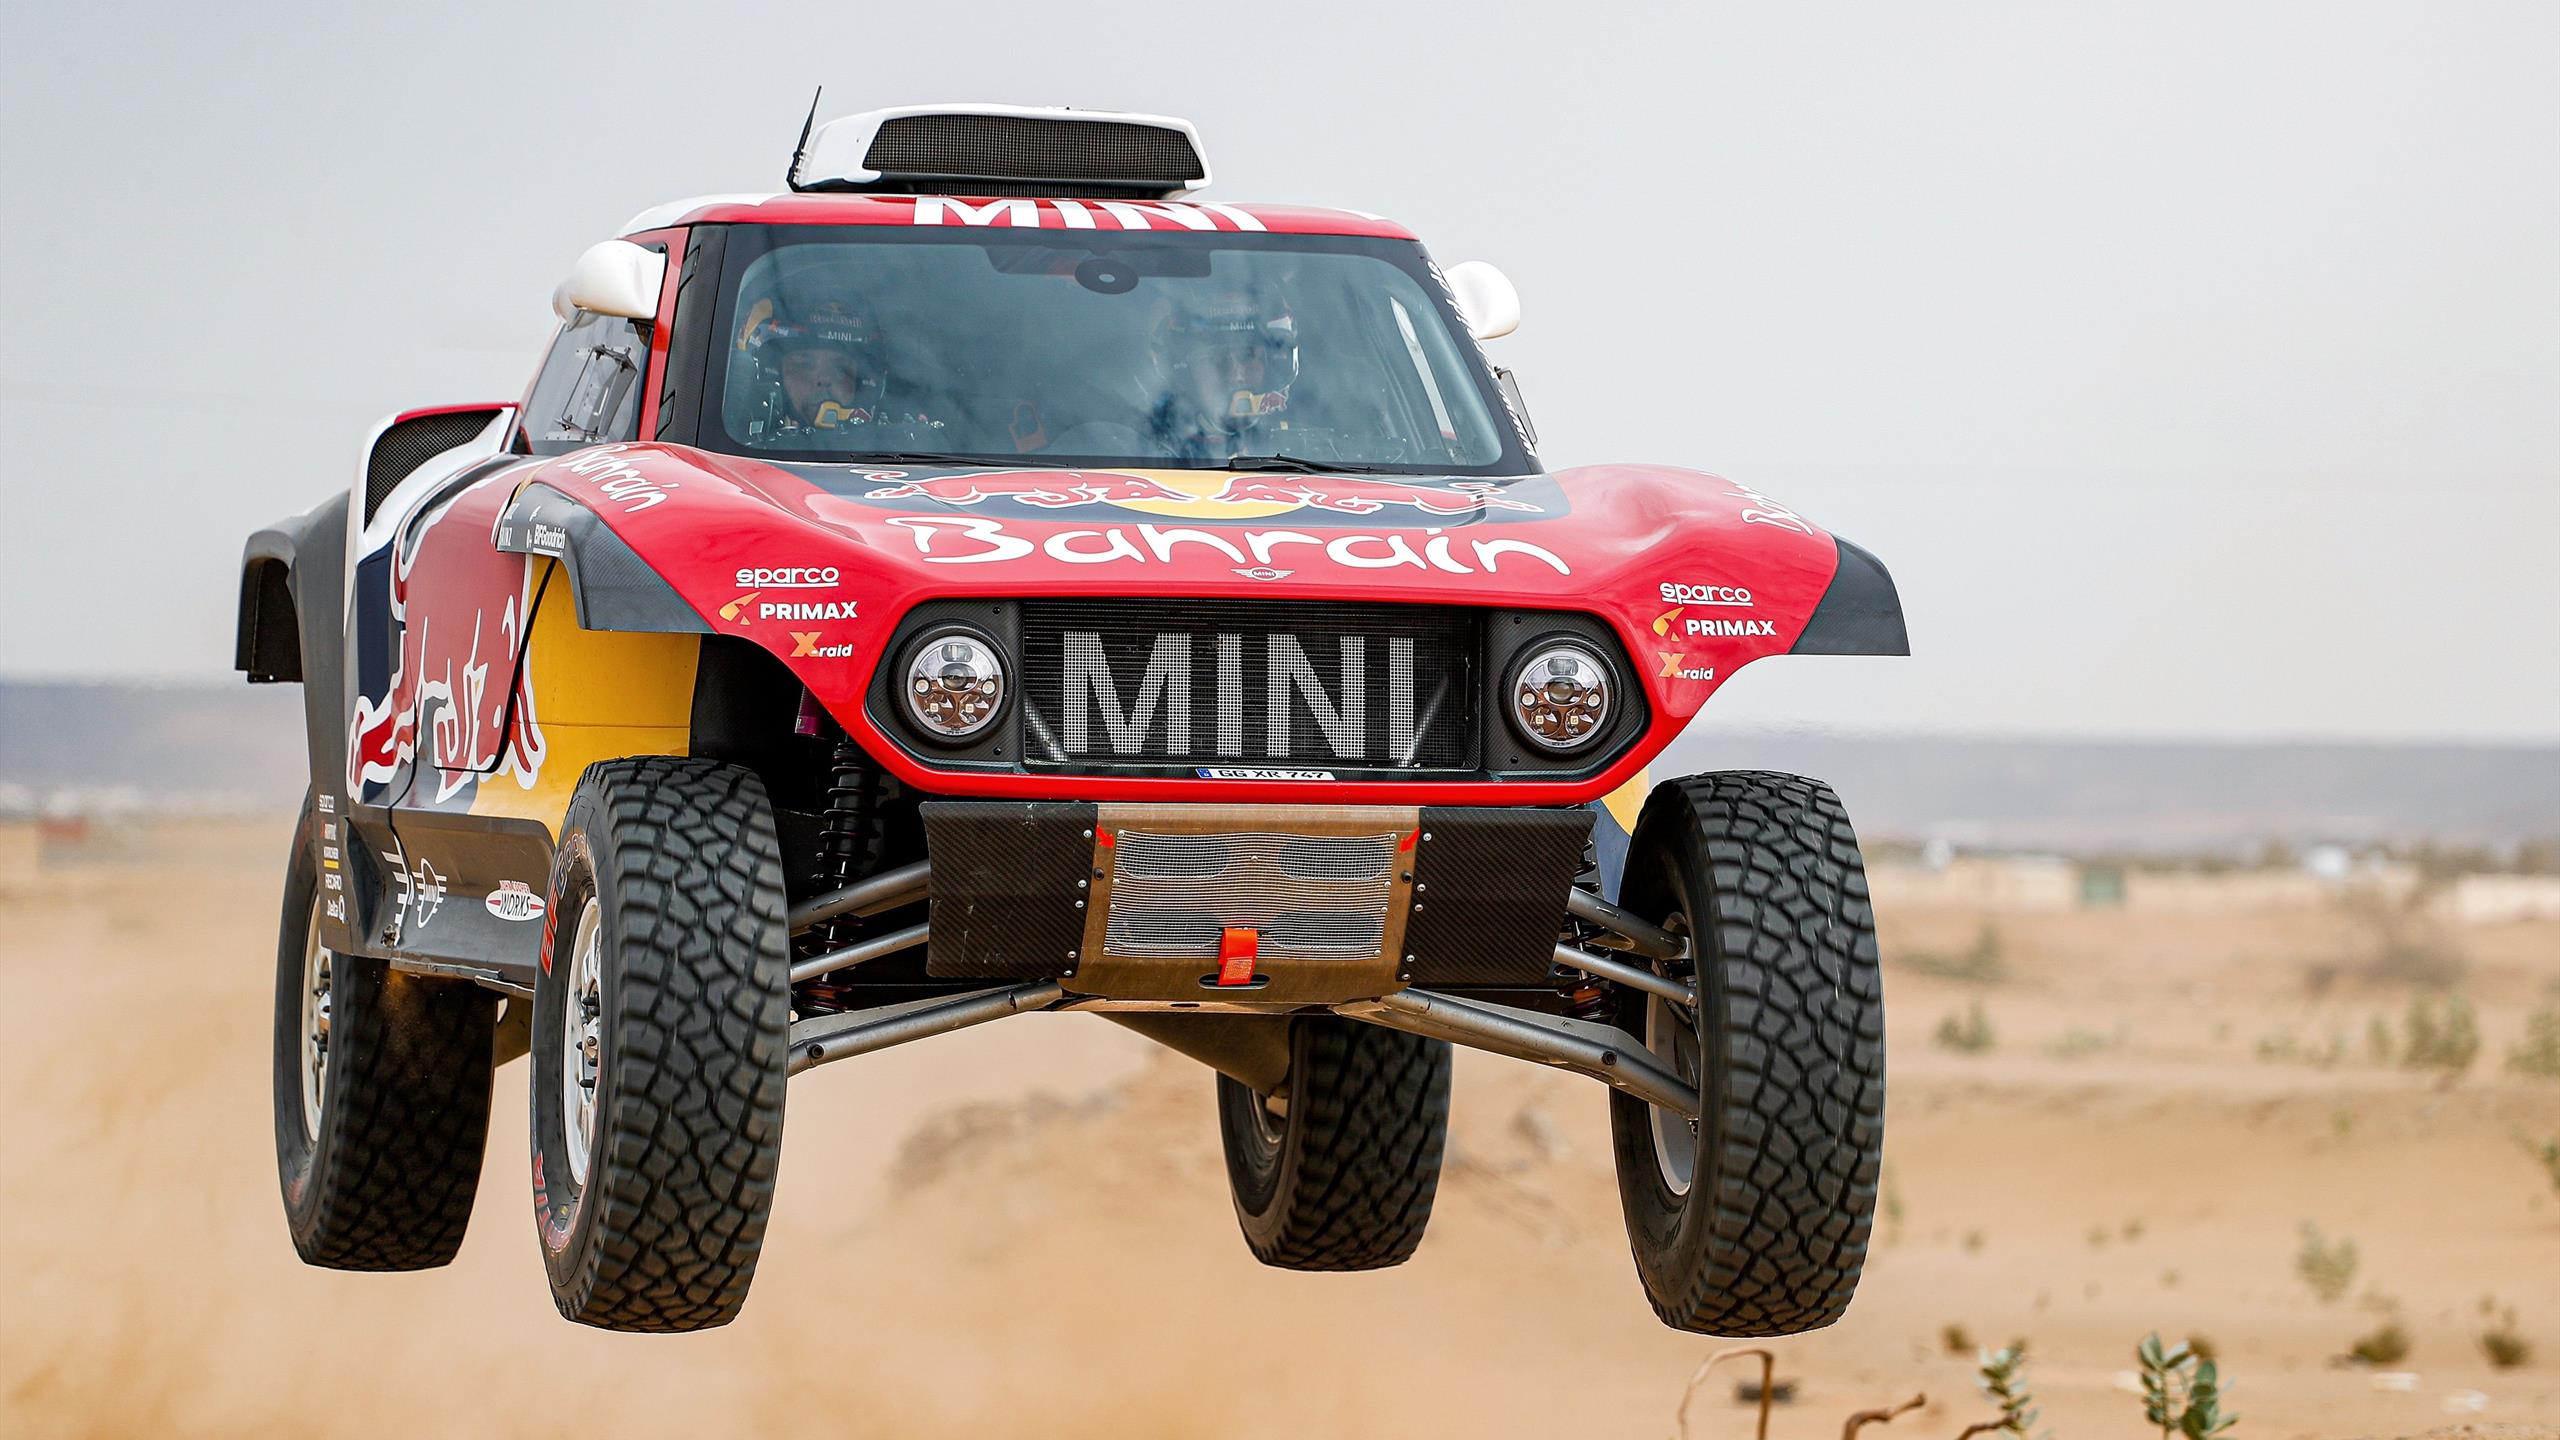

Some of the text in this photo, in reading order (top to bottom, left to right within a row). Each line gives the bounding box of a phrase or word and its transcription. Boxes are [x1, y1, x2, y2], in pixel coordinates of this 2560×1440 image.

[914, 197, 1268, 232] MINI
[827, 330, 852, 342] MINI
[533, 523, 566, 549] BFGoodrich
[886, 517, 1571, 576] Bahrain
[736, 566, 840, 588] sparco
[1660, 582, 1752, 606] sparco
[760, 601, 857, 620] PRIMAX
[1685, 619, 1776, 636] PRIMAX
[789, 631, 853, 657] X-raid
[1658, 651, 1714, 680] X-raid
[1064, 632, 1414, 760] MINI
[1218, 769, 1324, 779] GG XR 747
[499, 893, 531, 917] WORKS
